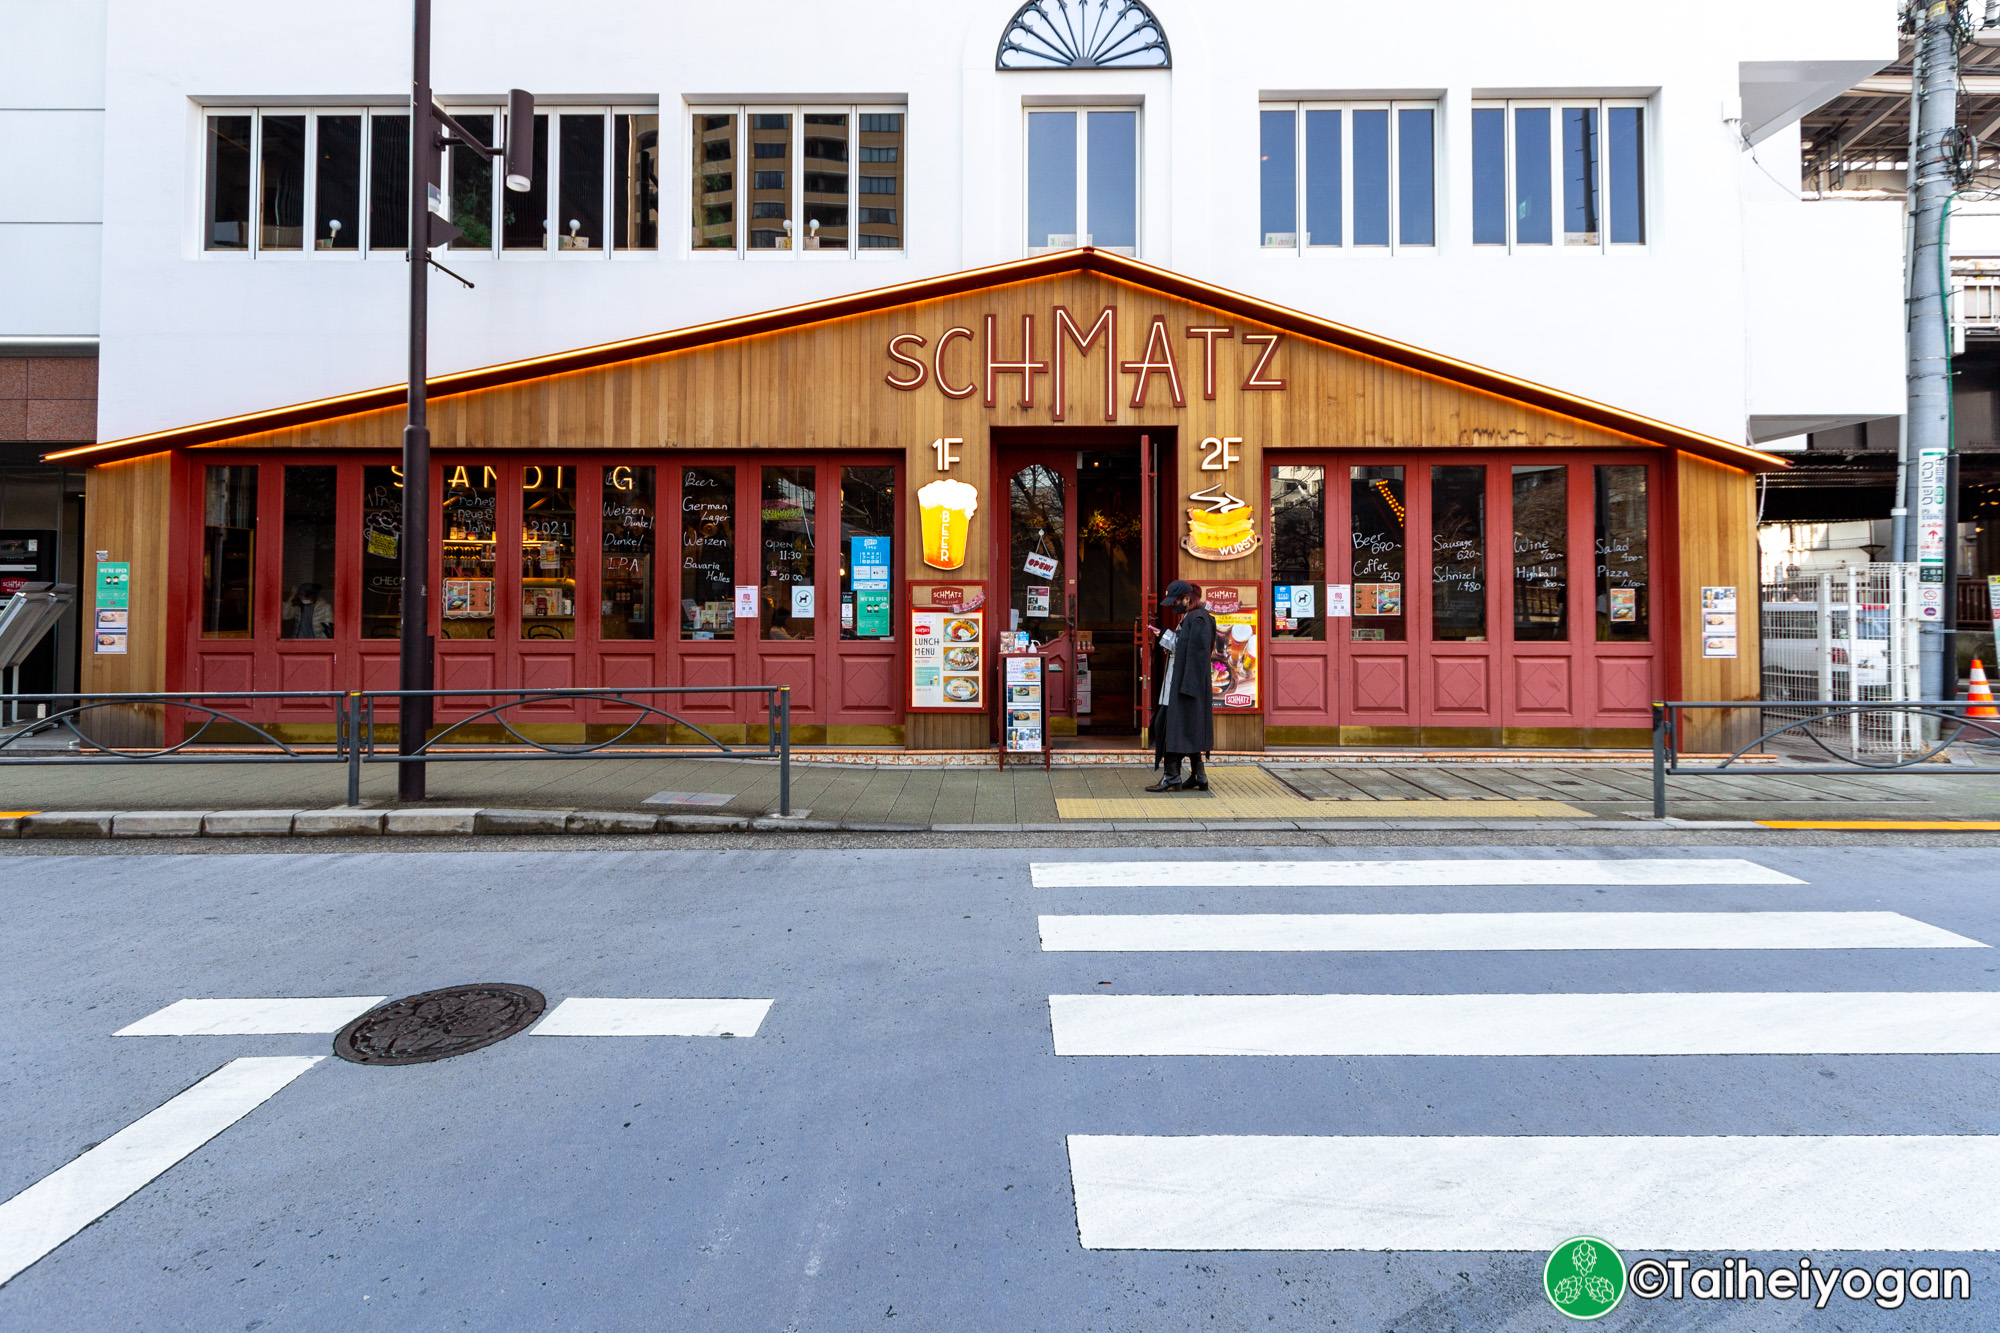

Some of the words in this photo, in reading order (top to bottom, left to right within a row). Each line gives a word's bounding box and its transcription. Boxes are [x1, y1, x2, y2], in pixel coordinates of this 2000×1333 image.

[885, 305, 1287, 422] SCHMATZ
[931, 437, 963, 471] 1F
[1199, 437, 1243, 471] 2F
[684, 471, 718, 487] Beer
[1921, 461, 1934, 506] クリニック
[602, 501, 646, 517] Weizen
[682, 496, 728, 512] German
[623, 515, 654, 530] Dunkel
[701, 511, 731, 526] Lager
[530, 520, 570, 536] 2021
[940, 510, 950, 562] BEER
[603, 531, 644, 547] Dunkel
[683, 531, 727, 547] Weizen
[1218, 535, 1256, 556] WURST
[1352, 532, 1385, 549] Beer
[1433, 534, 1473, 552] Sausage
[1513, 537, 1550, 553] Wine
[1594, 537, 1630, 555] Salad
[780, 550, 802, 560] 11:30
[683, 556, 720, 571] Bavaria
[1028, 558, 1054, 572] OPEN!
[1353, 558, 1389, 577] Coffee
[1596, 565, 1629, 578] Pizza
[705, 570, 731, 583] Helles
[1380, 571, 1400, 582] 450
[1432, 566, 1476, 583] Schnizel
[1516, 566, 1557, 581] Highball
[933, 590, 962, 600] SCHMATZ
[1207, 590, 1237, 600] SCHMATZ
[914, 638, 940, 646] LUNCH
[914, 647, 935, 656] MENU
[1227, 694, 1249, 705] SCHMATZ
